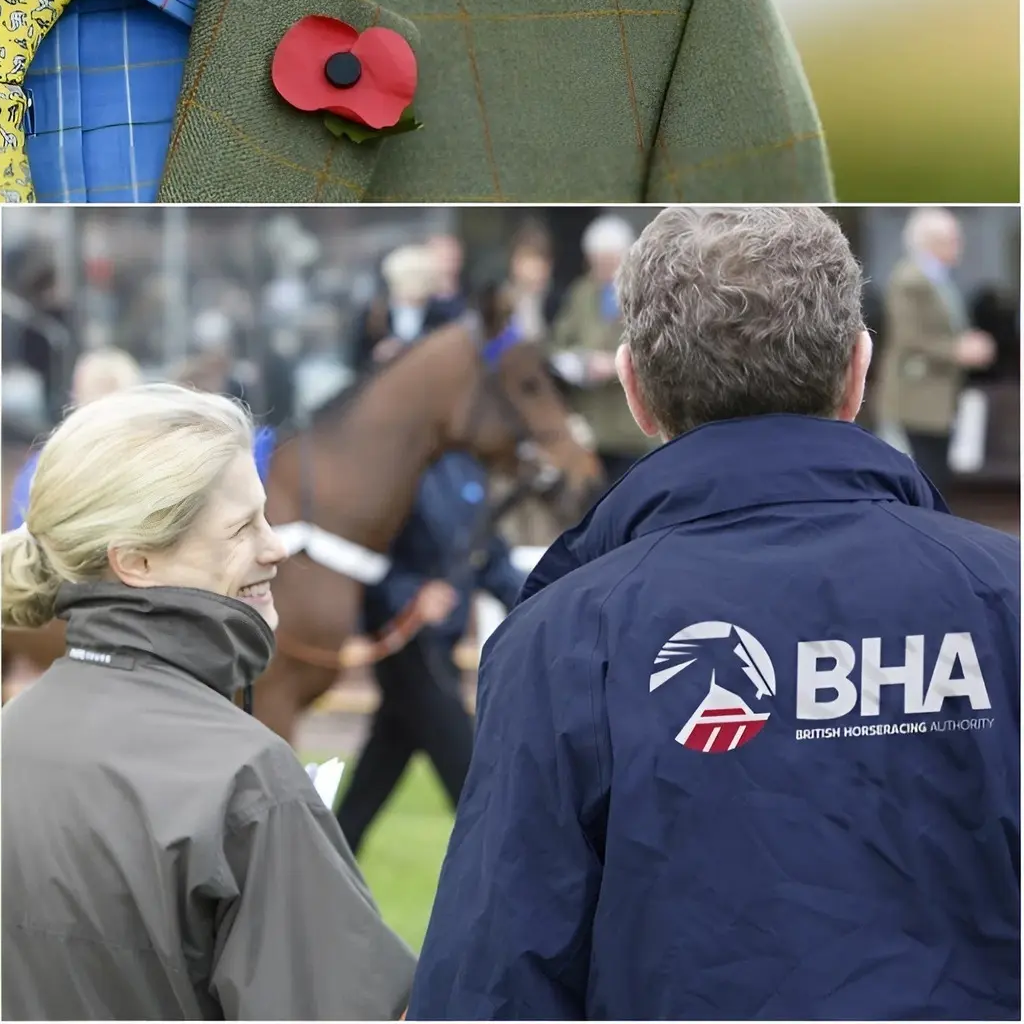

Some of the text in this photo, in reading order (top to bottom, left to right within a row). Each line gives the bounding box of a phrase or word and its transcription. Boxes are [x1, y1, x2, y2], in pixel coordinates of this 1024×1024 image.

[796, 632, 992, 720] BHA
[796, 718, 995, 740] BRITISH HORSERACING AUTHORITY
